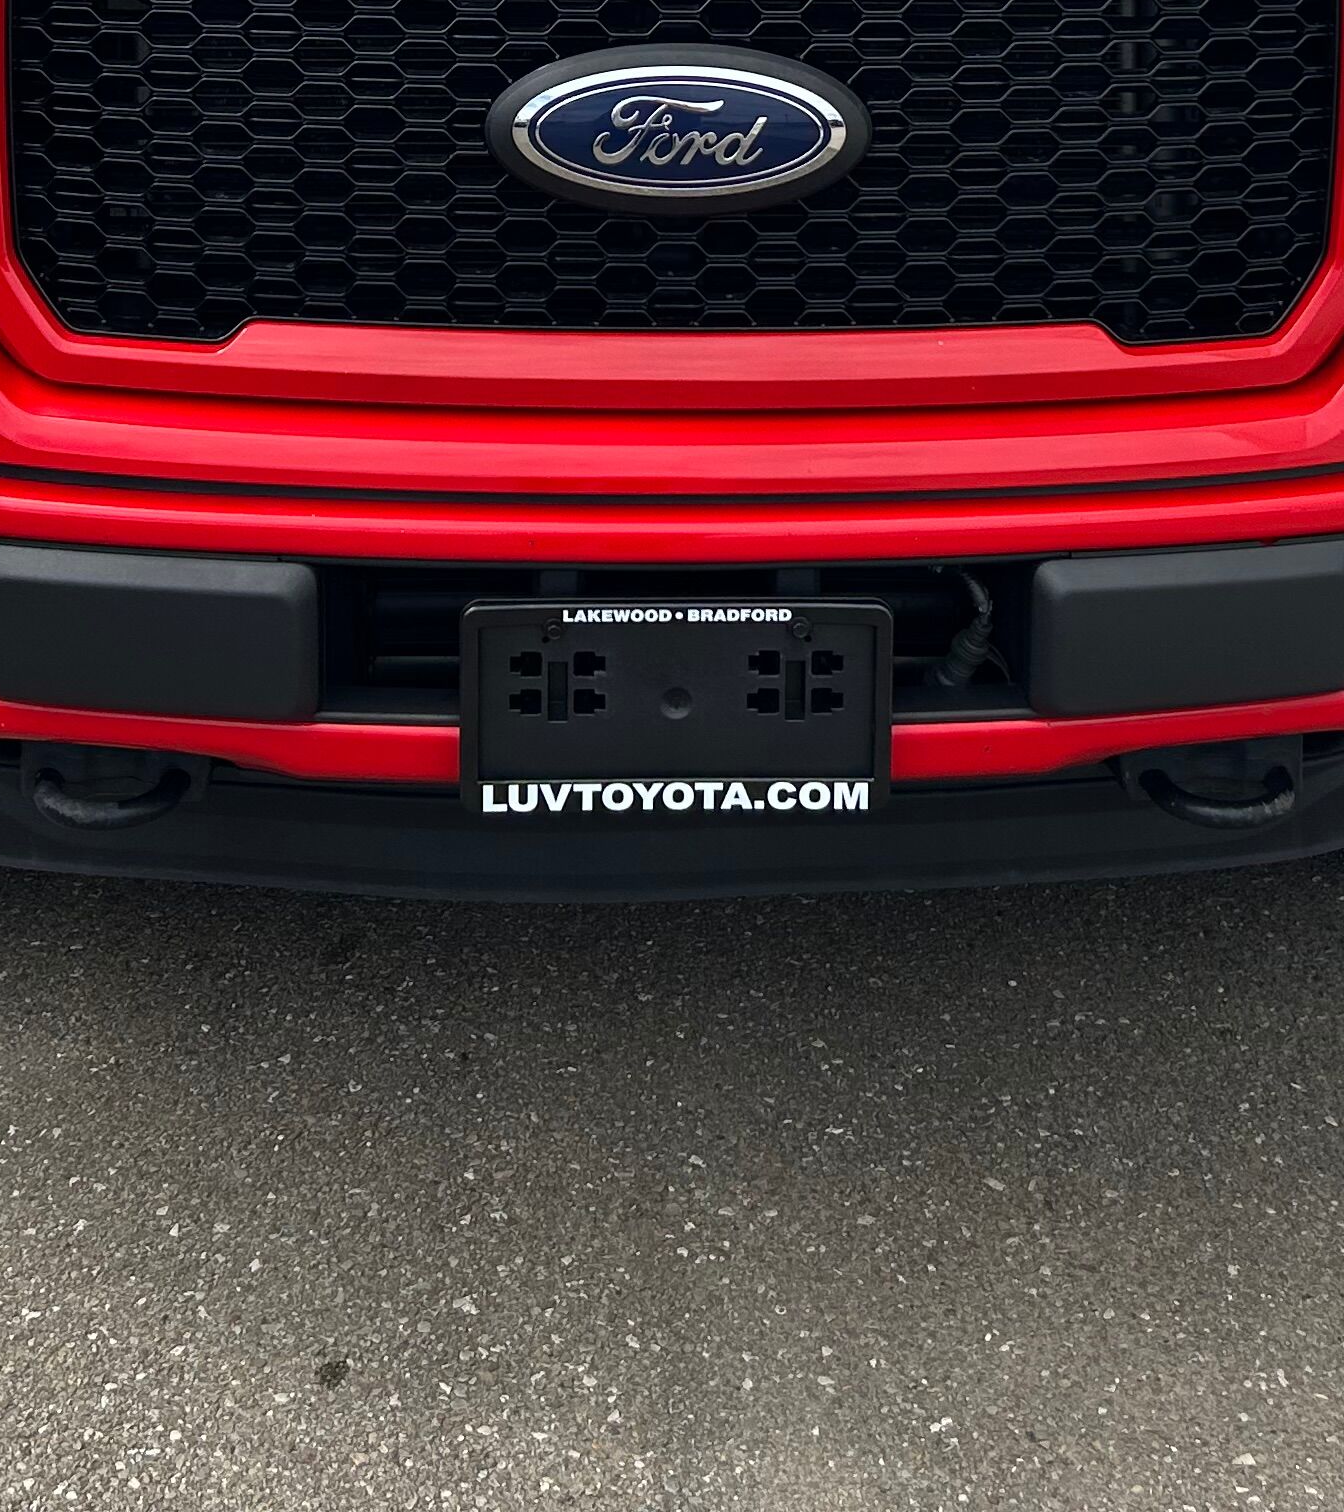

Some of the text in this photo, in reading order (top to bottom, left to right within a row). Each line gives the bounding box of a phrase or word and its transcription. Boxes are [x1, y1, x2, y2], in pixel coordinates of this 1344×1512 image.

[592, 95, 768, 166] Ford
[562, 608, 793, 624] LAKEWOOD BRADFORD
[482, 781, 870, 813] LUVTOYOTA.COM
